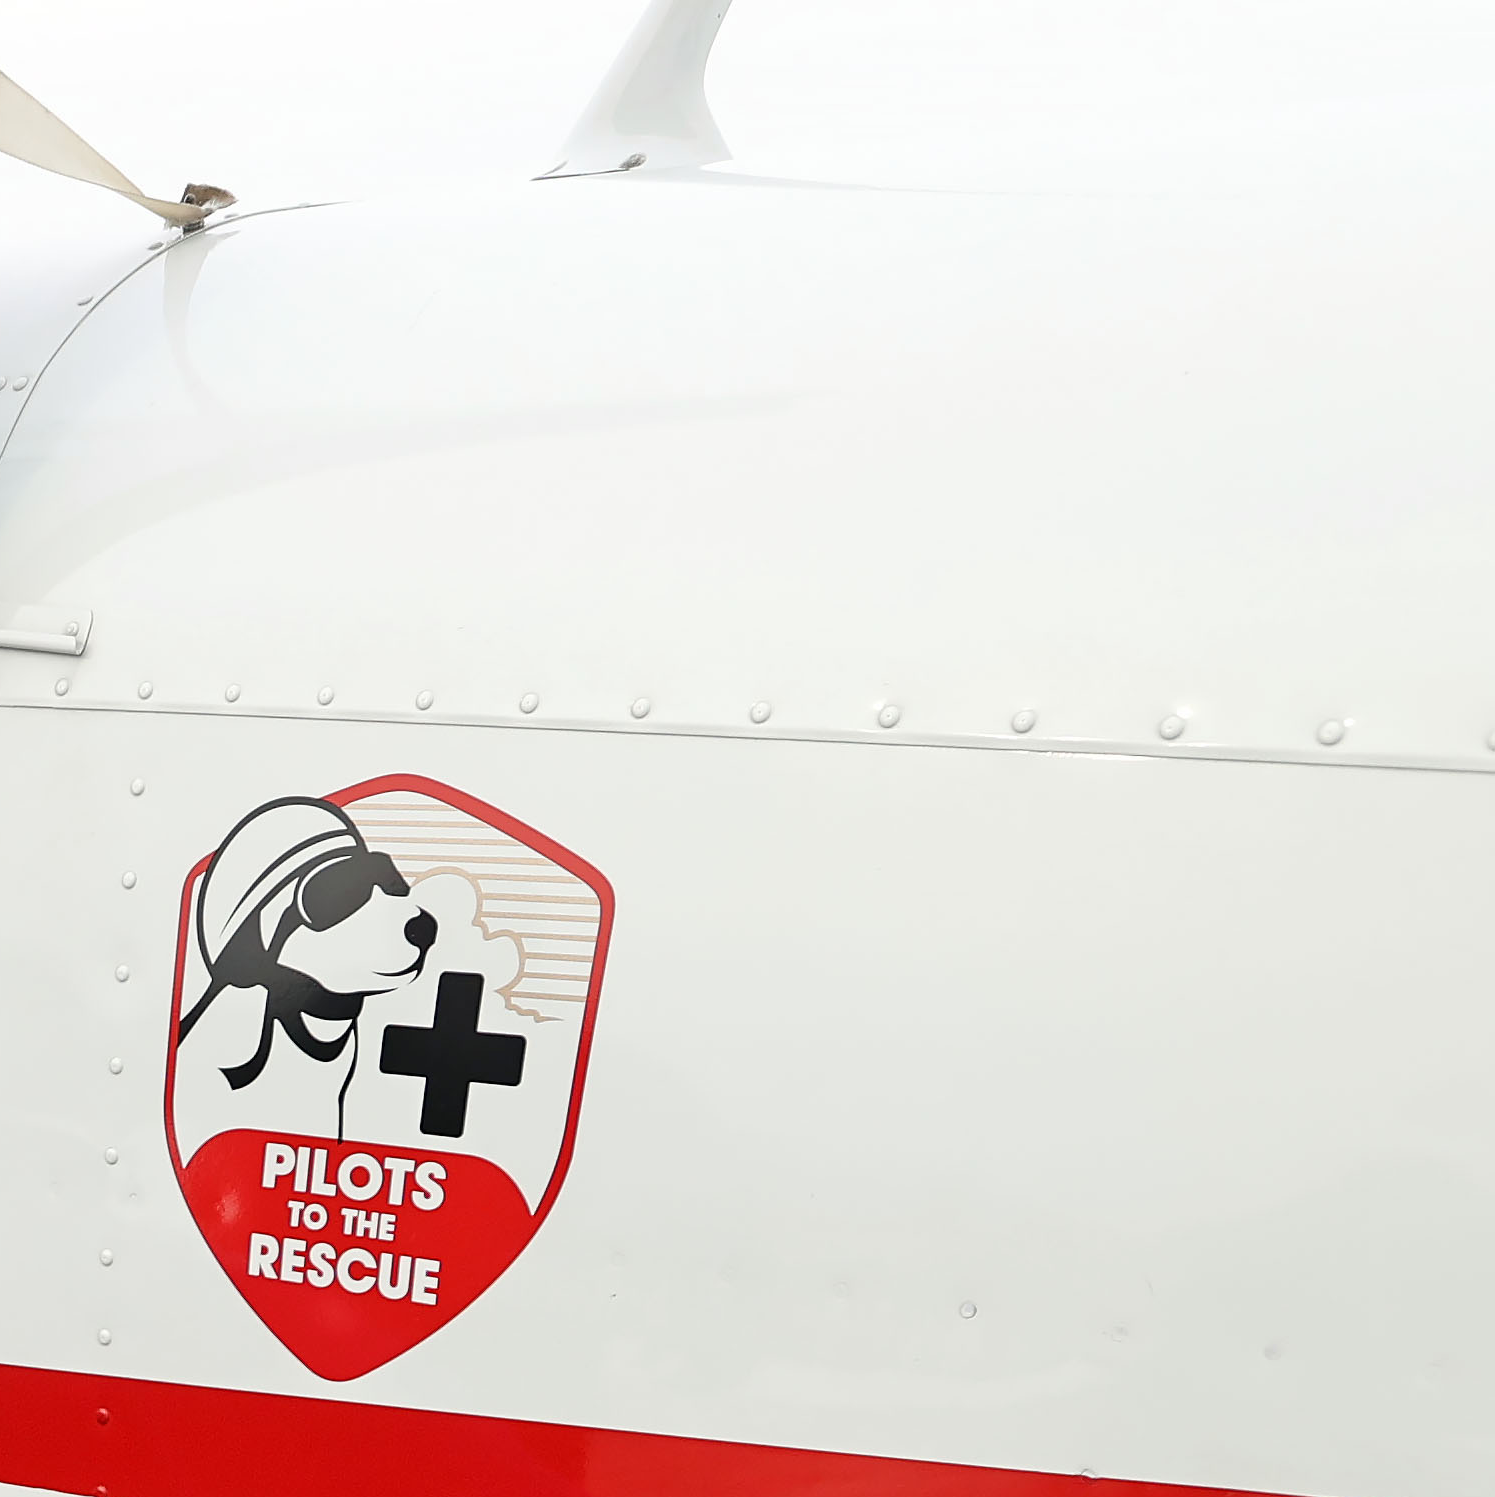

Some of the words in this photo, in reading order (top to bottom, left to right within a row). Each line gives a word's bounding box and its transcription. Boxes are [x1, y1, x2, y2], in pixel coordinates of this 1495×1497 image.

[261, 1142, 447, 1211] PILOTS
[287, 1200, 328, 1231] TO
[340, 1207, 396, 1242] THE
[248, 1232, 441, 1306] RESCUE
